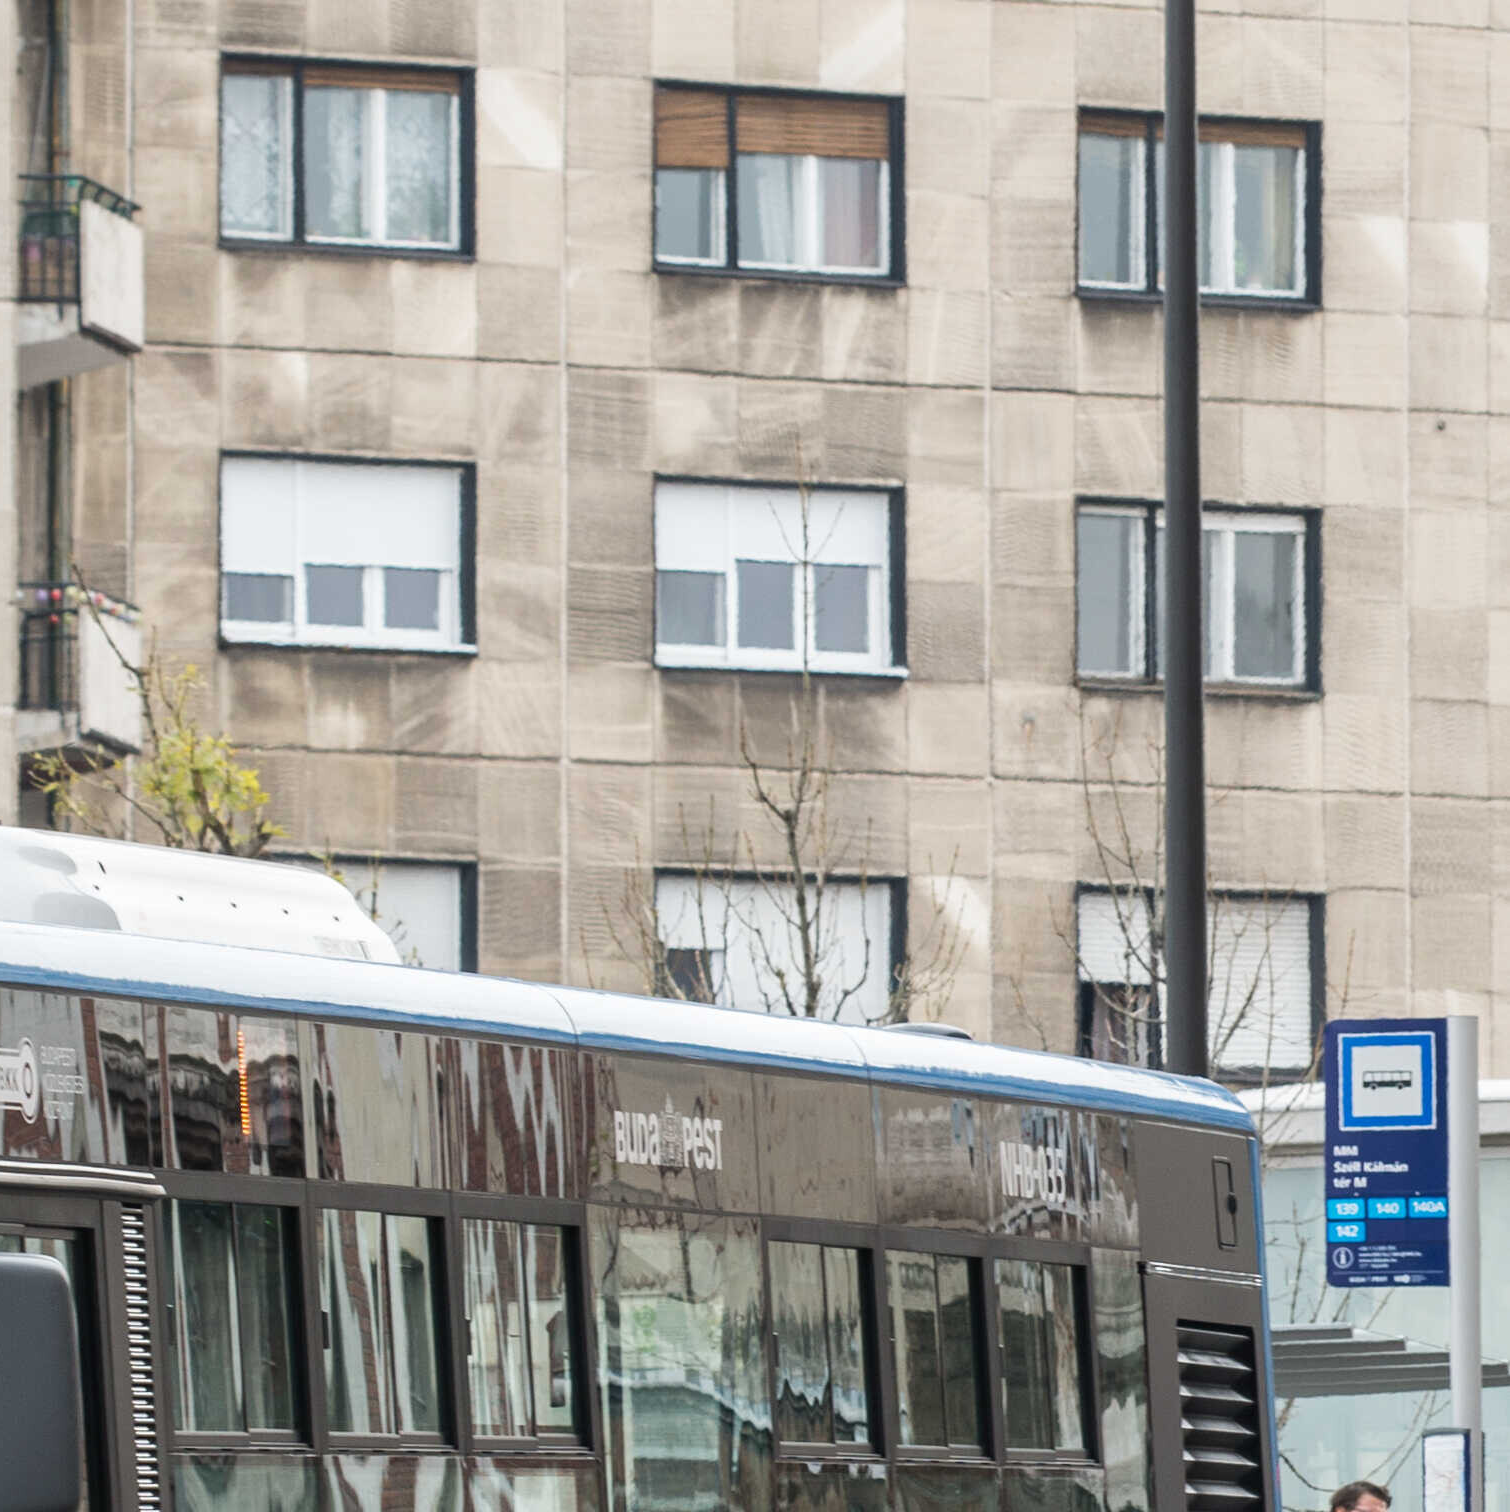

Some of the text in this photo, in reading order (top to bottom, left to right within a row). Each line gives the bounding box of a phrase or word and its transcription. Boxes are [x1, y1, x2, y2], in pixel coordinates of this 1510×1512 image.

[1000, 1141, 1066, 1203] NHB-035
[1333, 1160, 1409, 1173] Széll Kálmán
[1333, 1176, 1352, 1188] tér
[1335, 1201, 1446, 1216] 139 140 140A
[1335, 1225, 1359, 1238] 142
